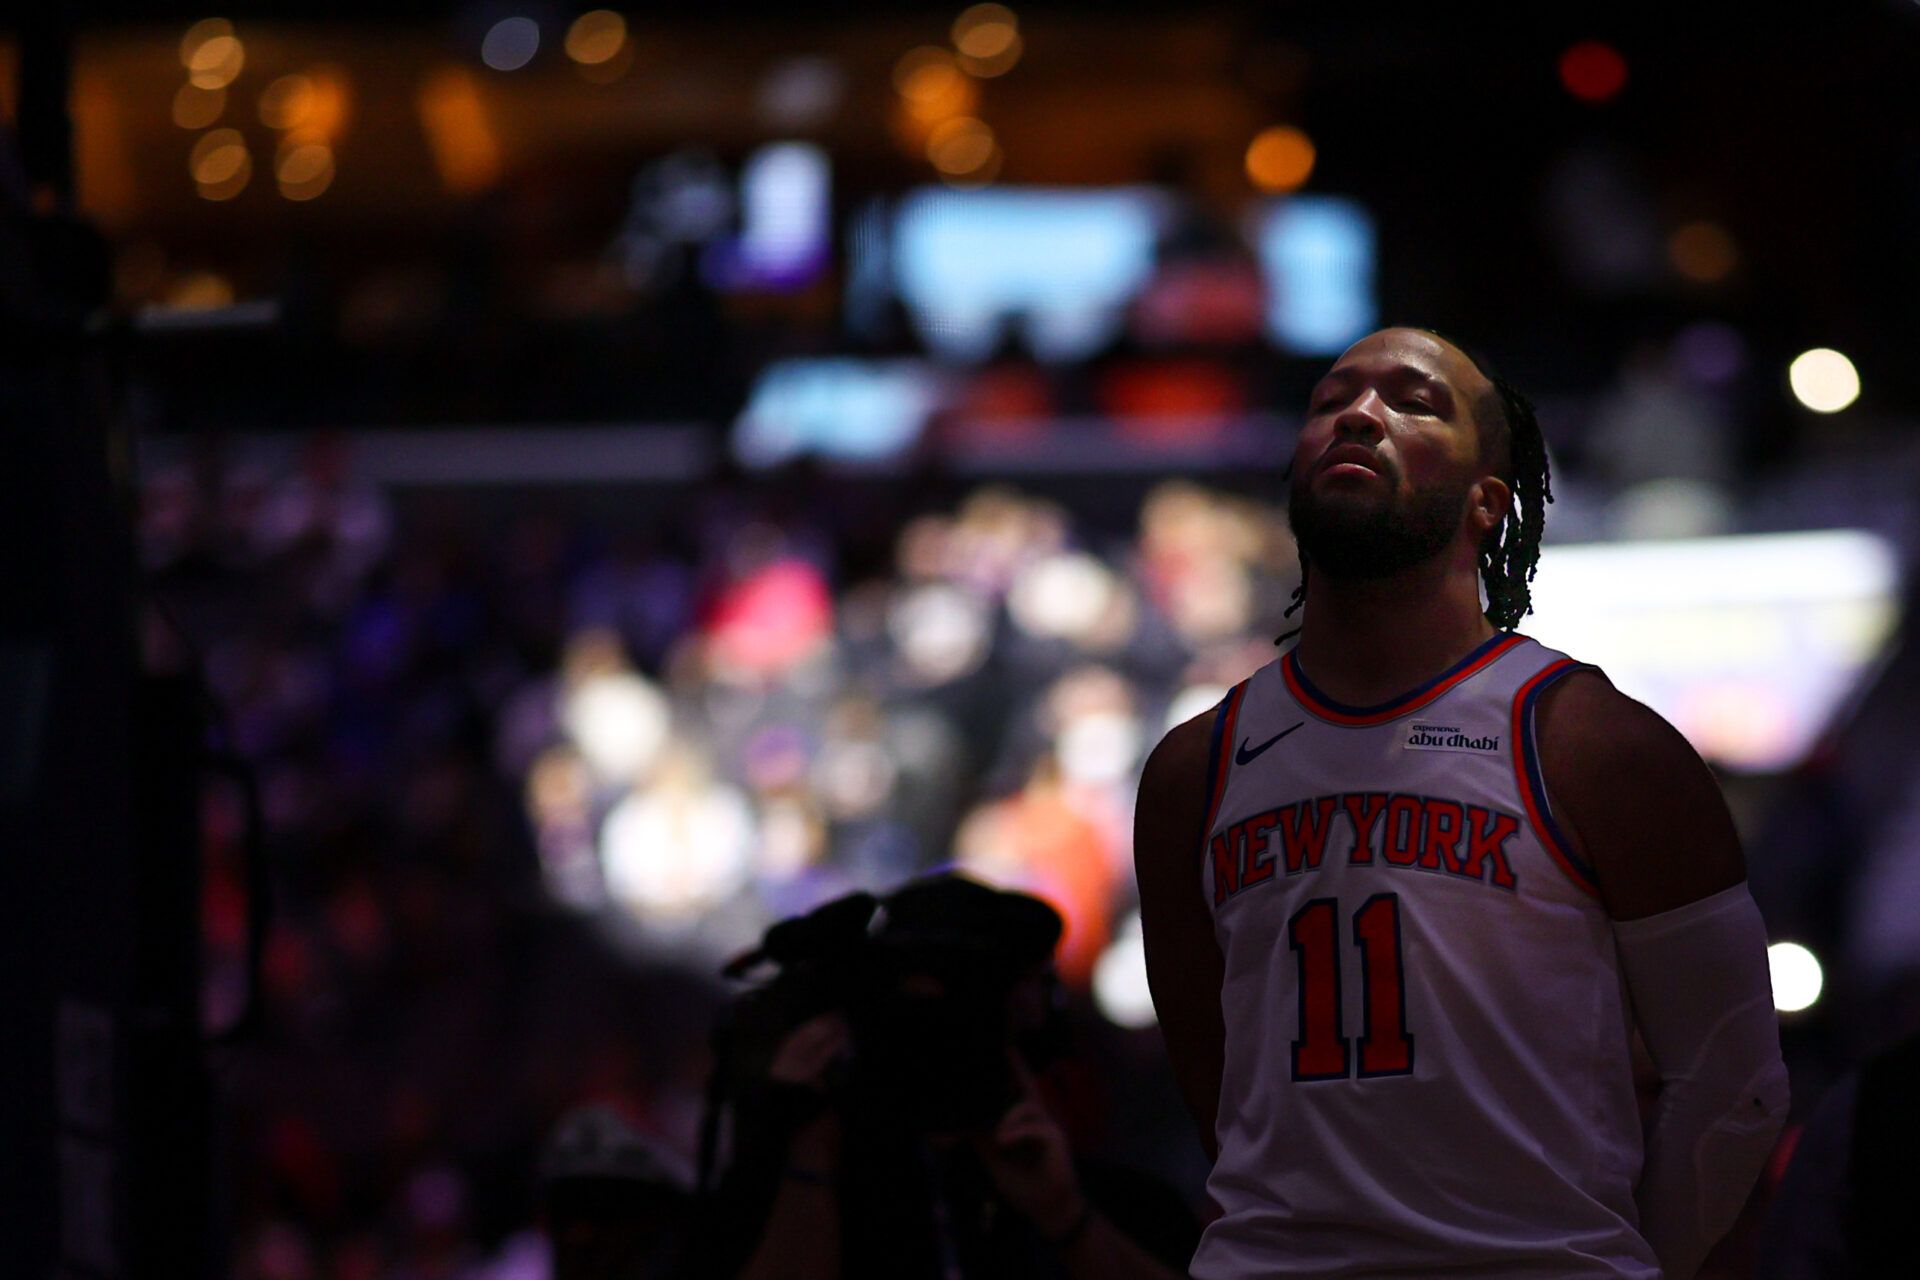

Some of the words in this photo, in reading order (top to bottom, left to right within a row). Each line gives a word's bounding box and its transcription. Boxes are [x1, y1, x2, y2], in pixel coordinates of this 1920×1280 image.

[1408, 733, 1443, 746] abu
[1446, 734, 1500, 751] dhabi
[1210, 795, 1338, 909] NEW
[1342, 792, 1520, 892] YORK
[1288, 893, 1414, 1082] 11
